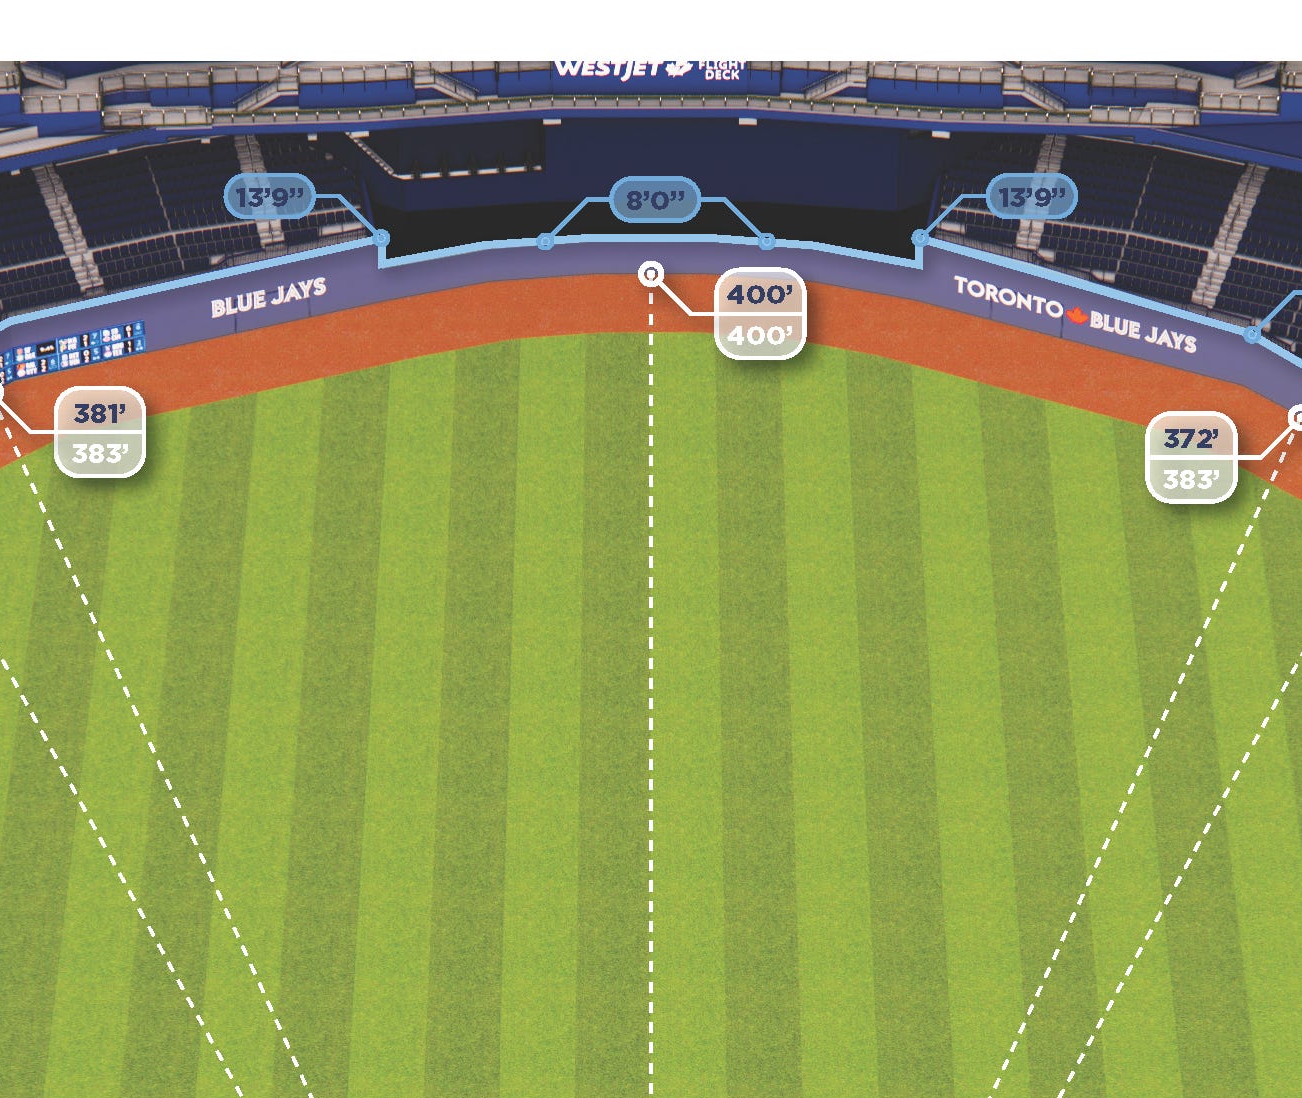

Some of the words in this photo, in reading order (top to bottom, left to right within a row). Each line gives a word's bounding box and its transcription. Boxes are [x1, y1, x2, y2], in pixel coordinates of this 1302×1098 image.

[554, 61, 664, 82] WESTJET
[699, 61, 746, 70] FLIGHT
[705, 70, 739, 80] DECK
[211, 289, 267, 318] BLUE
[271, 277, 327, 305] JAYS
[953, 275, 1063, 318] TORONTO
[1090, 310, 1141, 340] BLUE
[1143, 326, 1197, 353] JAYS
